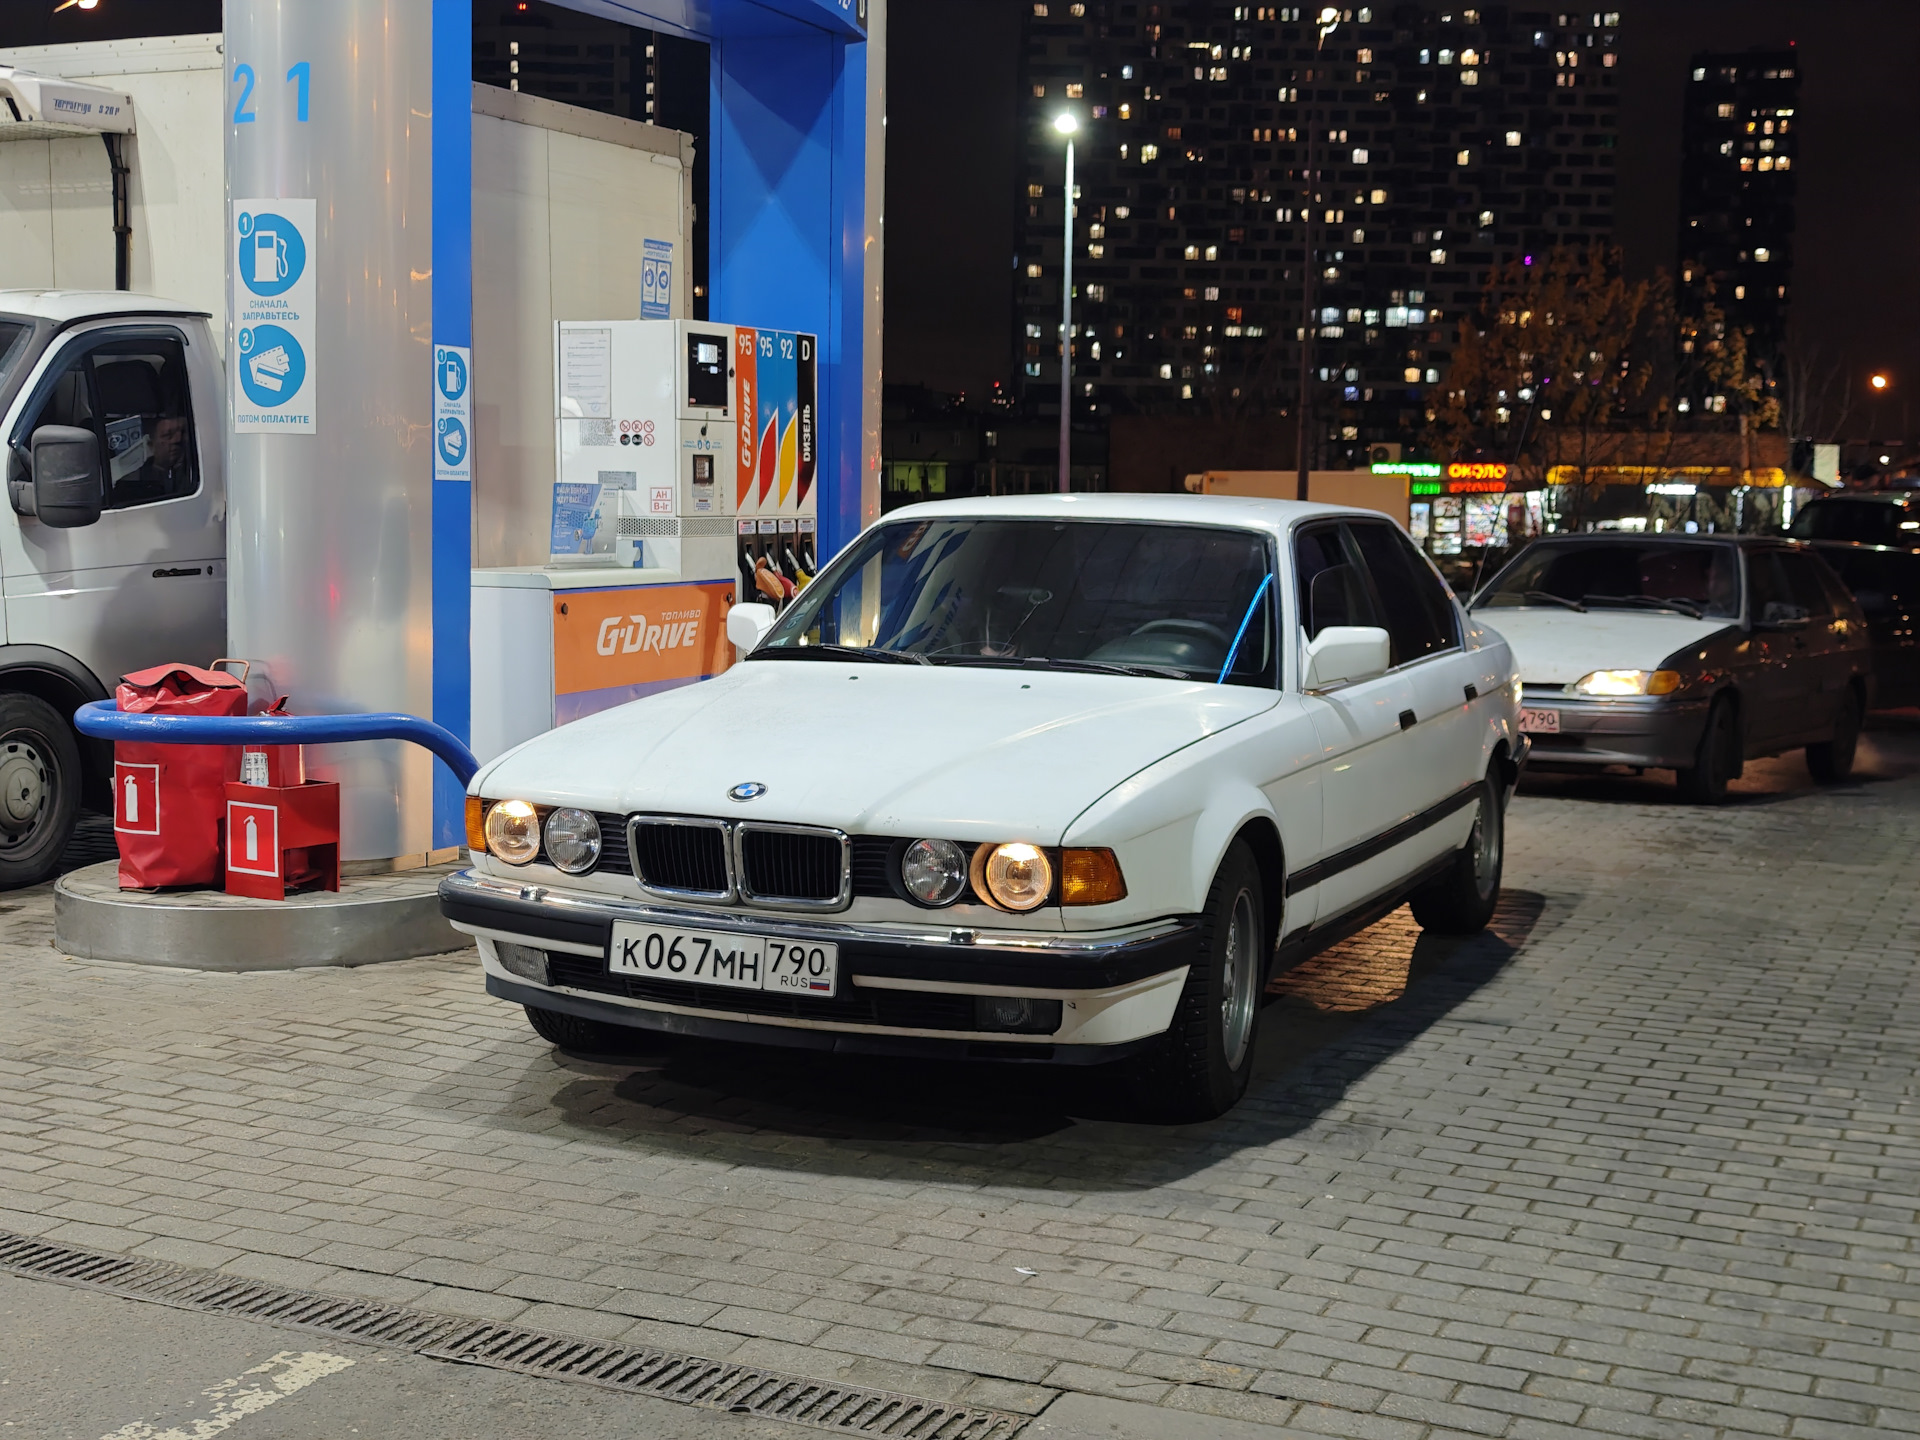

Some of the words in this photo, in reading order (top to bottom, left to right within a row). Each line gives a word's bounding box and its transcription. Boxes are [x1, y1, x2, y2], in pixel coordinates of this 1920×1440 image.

[233, 63, 255, 124] 2
[286, 61, 310, 122] 1
[242, 216, 248, 231] 1
[249, 300, 289, 309] СНАЧАЛА
[242, 311, 300, 321] ЗАПРАВЬТЕСЬ
[242, 332, 249, 347] 2
[738, 334, 752, 356] 95
[760, 337, 773, 358] 95
[780, 339, 794, 360] 92
[802, 340, 811, 361] D
[237, 414, 260, 424] ПОТОМ
[261, 414, 310, 425] ОПЛАТИТЕ
[661, 609, 701, 621] ТОПЛИВО
[1529, 711, 1555, 726] 790
[622, 933, 759, 982] К067МН
[769, 943, 826, 977] 790
[780, 975, 808, 988] RUS
